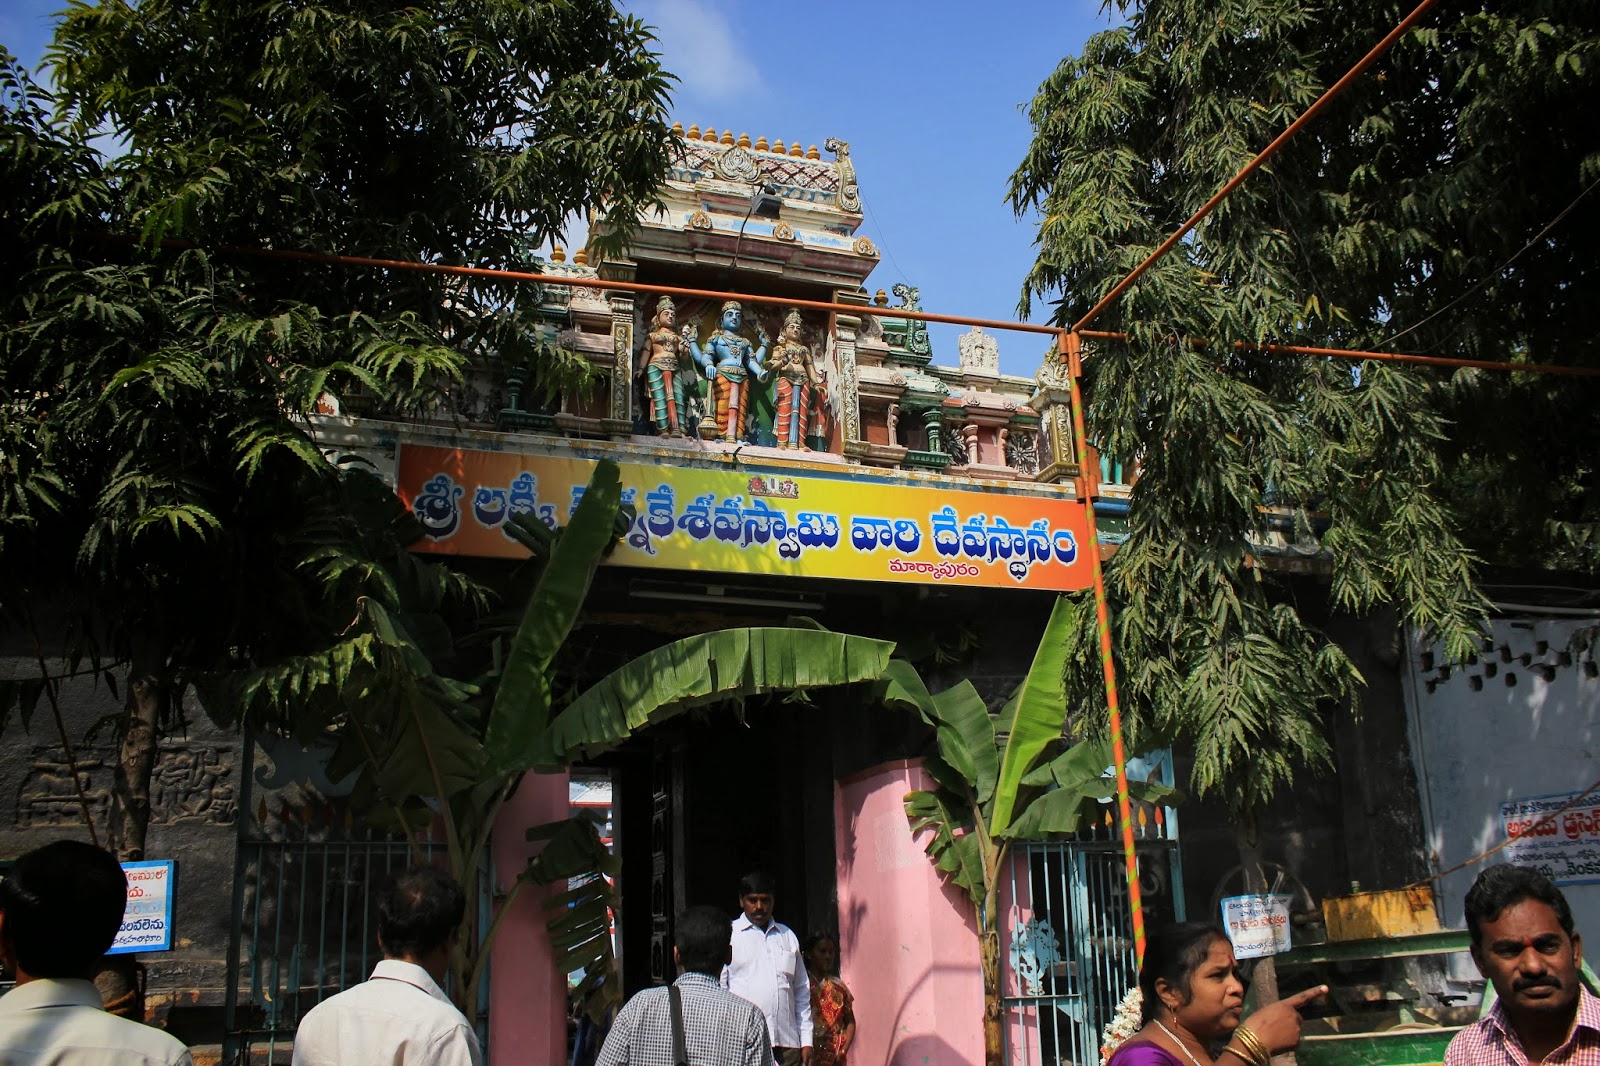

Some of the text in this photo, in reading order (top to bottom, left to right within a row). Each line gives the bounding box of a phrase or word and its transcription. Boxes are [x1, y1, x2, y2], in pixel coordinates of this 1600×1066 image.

[414, 474, 462, 537] శ్రీ
[852, 516, 922, 553] వారి
[932, 508, 1077, 581] దేవస్థానం
[889, 560, 979, 578] మార్కాపురం
